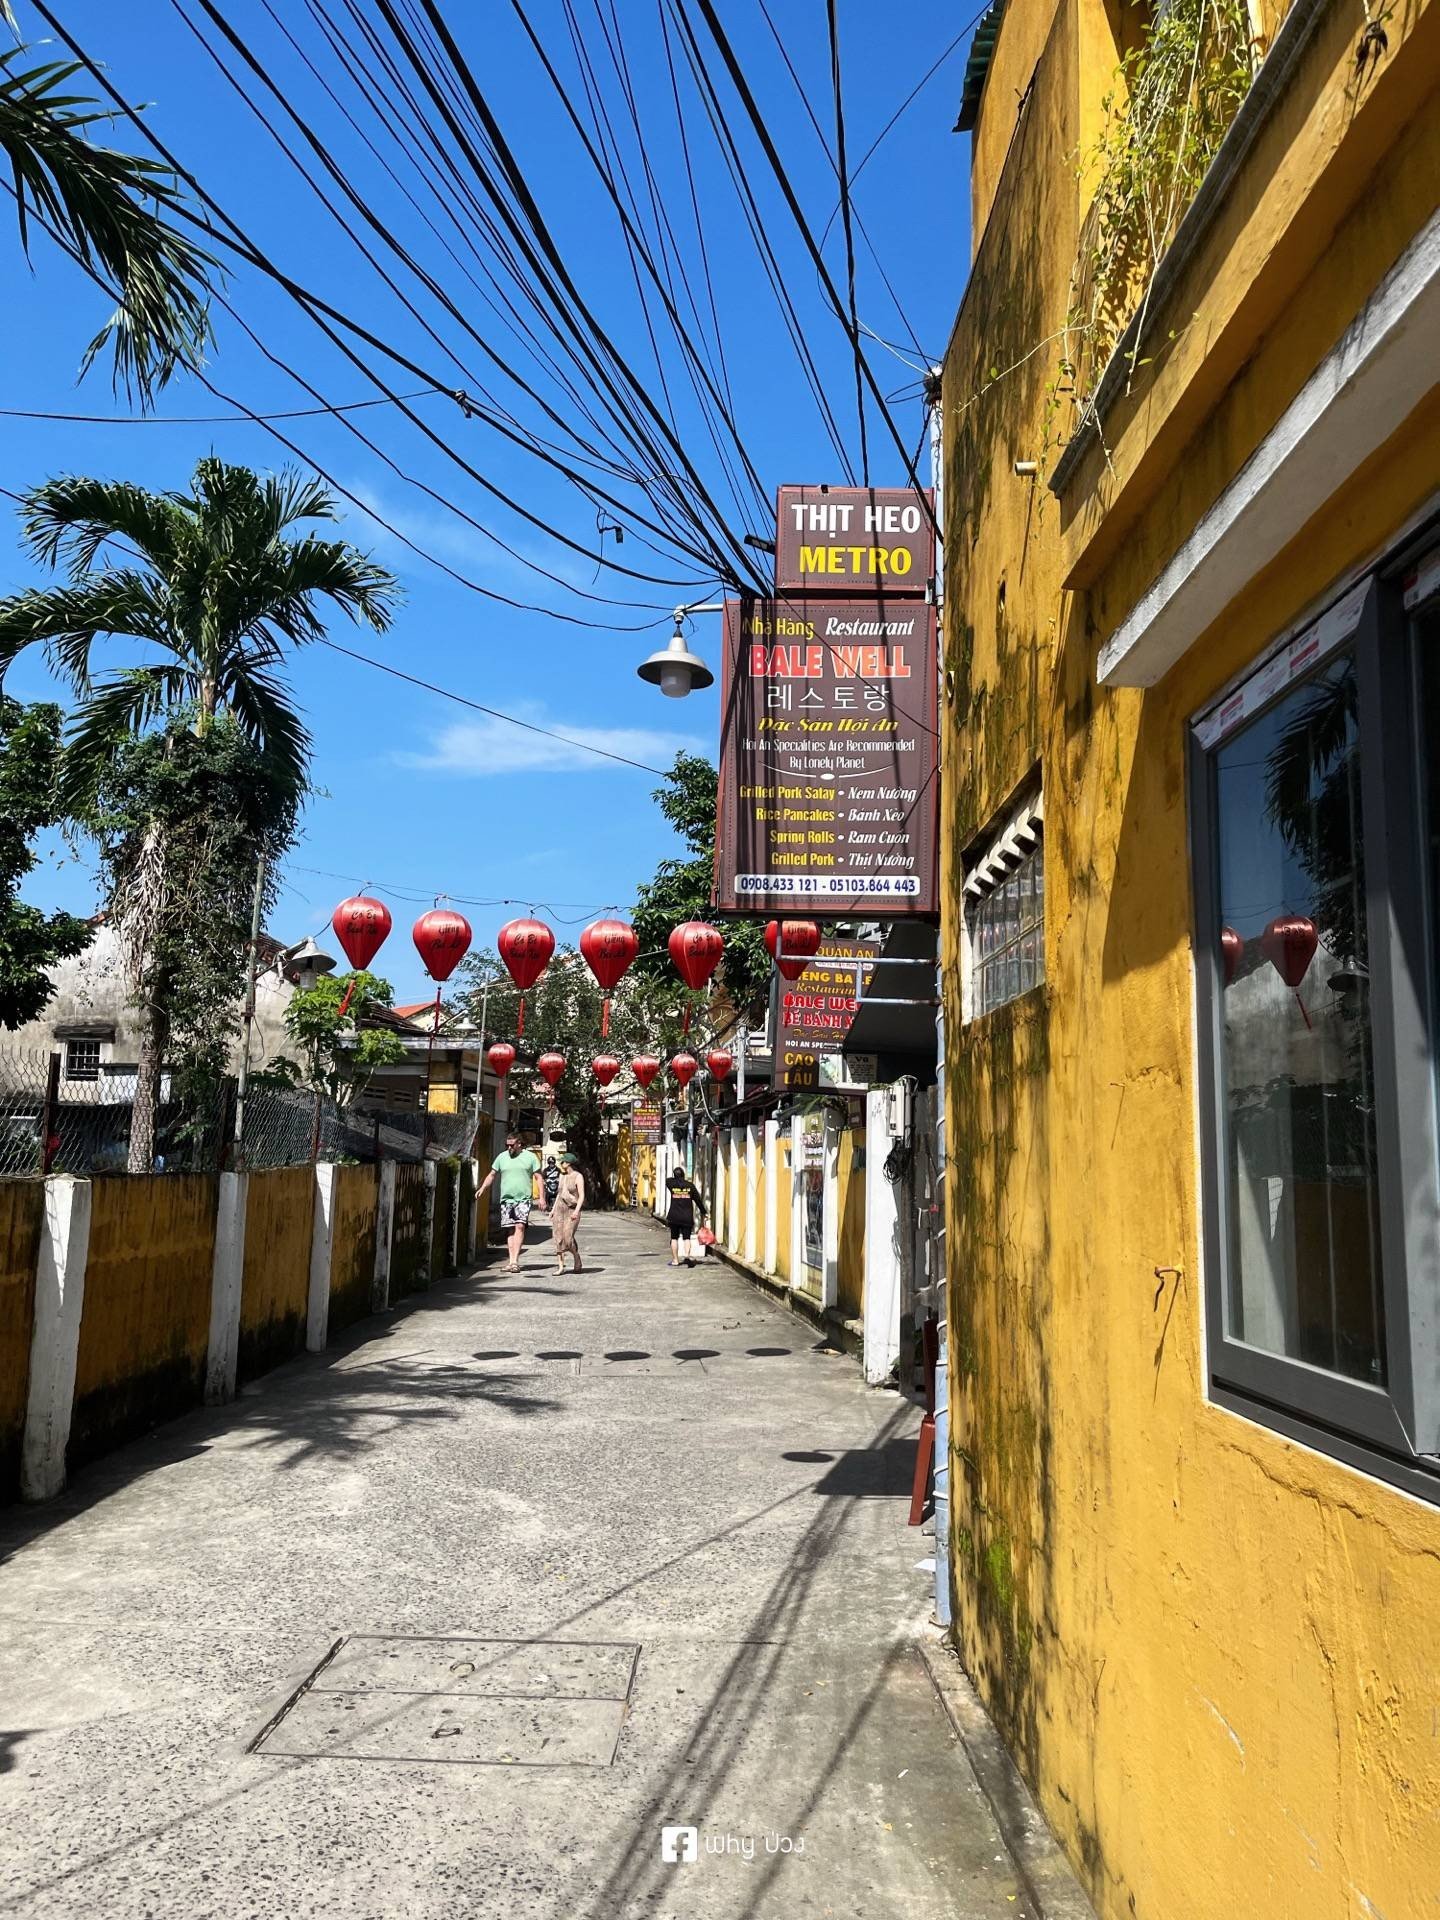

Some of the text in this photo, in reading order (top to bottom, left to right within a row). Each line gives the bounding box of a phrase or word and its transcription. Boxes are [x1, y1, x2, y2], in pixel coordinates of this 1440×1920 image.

[791, 503, 921, 538] THỊT HEO
[799, 545, 912, 575] METRO
[744, 616, 915, 640] Nhà Hàng Restaurant
[749, 645, 911, 678] BALE WELL
[767, 684, 890, 711] 레스토랑
[871, 718, 899, 731] An
[759, 739, 770, 750] An
[829, 739, 843, 751] Are
[847, 739, 915, 751] Recommended
[790, 756, 865, 770] By Lonely Planet
[740, 785, 774, 798] Grilled
[778, 786, 802, 799] Pork
[805, 786, 835, 800] Satay
[848, 786, 875, 799] Nem
[756, 808, 780, 820] Rice
[784, 808, 835, 821] Pancakes
[848, 807, 881, 821] Bánh
[770, 830, 805, 845] Spring
[808, 831, 835, 844] Rolls
[848, 830, 876, 844] Ram
[771, 852, 807, 865] Grilled
[810, 853, 835, 866] Pork
[849, 853, 873, 870] Thịt
[741, 877, 794, 891] 0908.433
[799, 878, 817, 891] 121
[830, 879, 890, 892] 05103.864
[894, 879, 916, 893] 443
[796, 982, 856, 995] Restauran
[783, 994, 825, 1009] BALE
[784, 1052, 814, 1066] CAO
